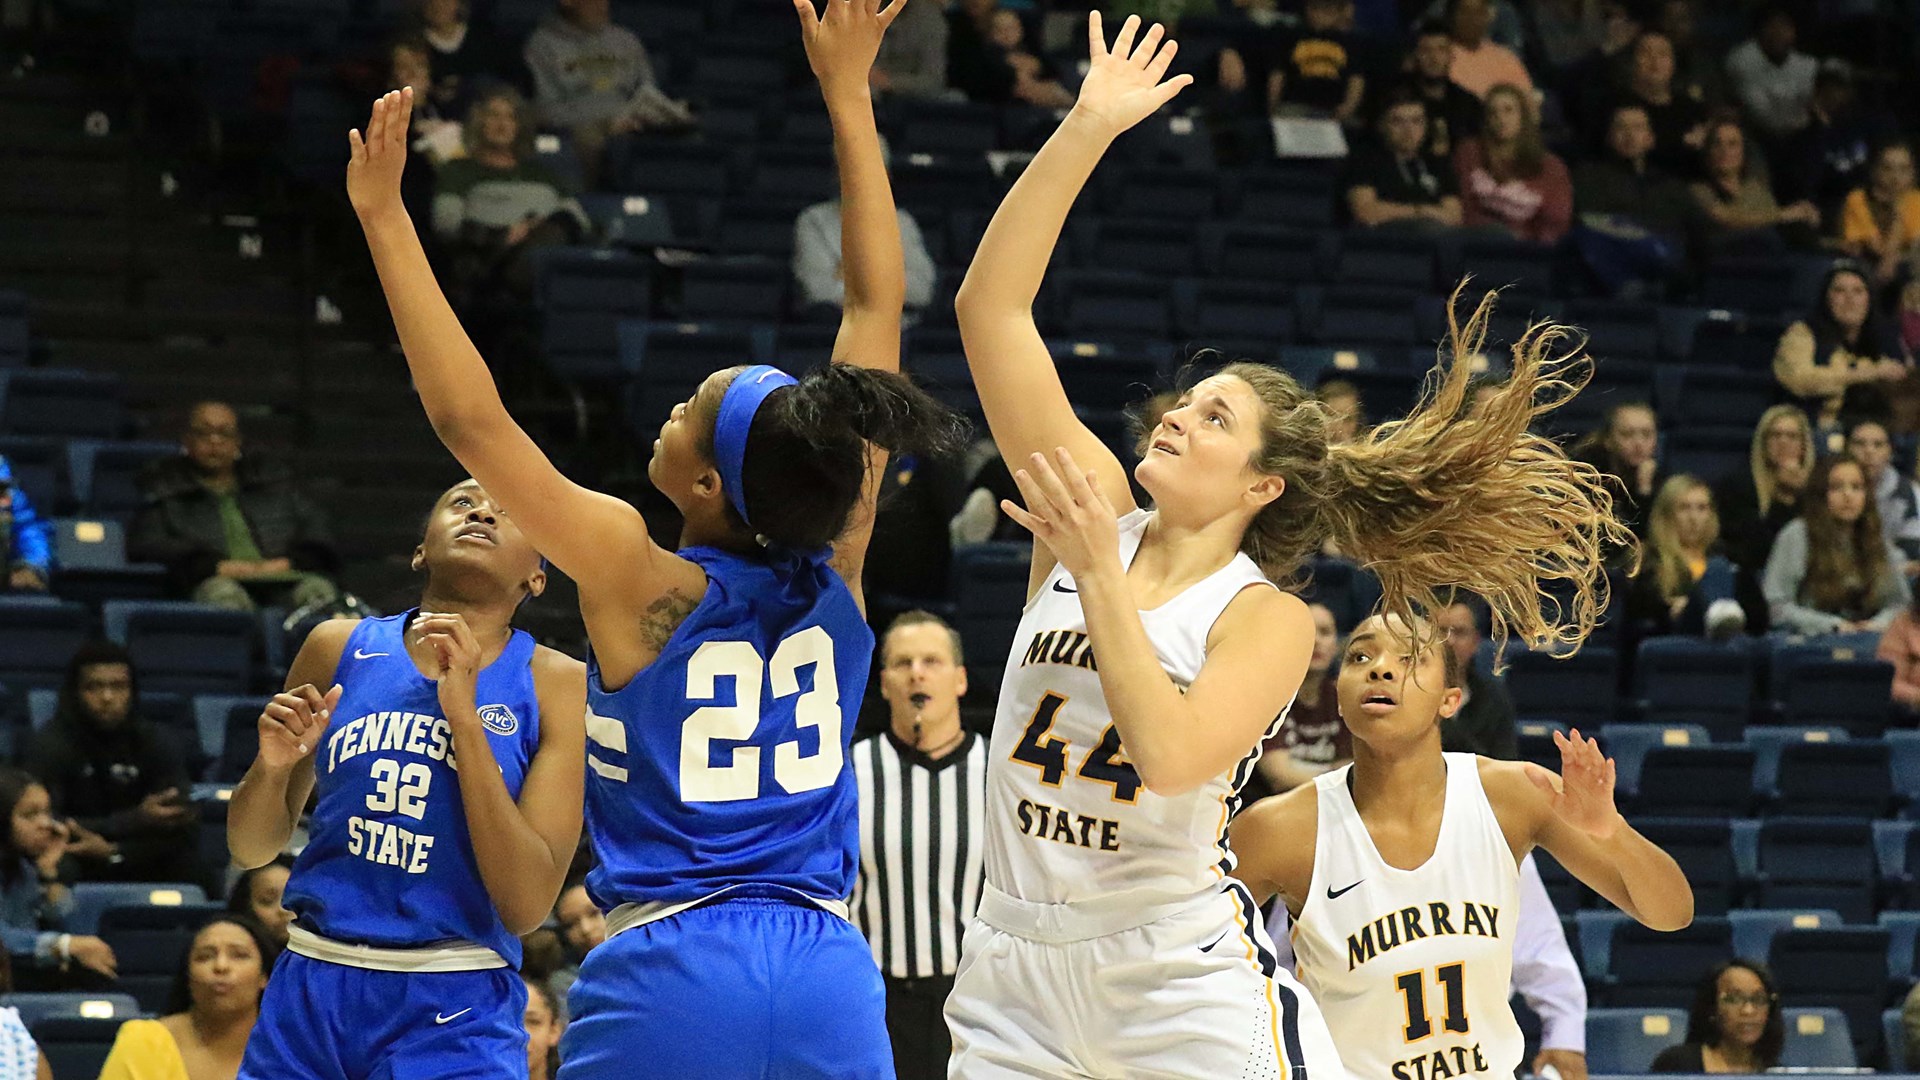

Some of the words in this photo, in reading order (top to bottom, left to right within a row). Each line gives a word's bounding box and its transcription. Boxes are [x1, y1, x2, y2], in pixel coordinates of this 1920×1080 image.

[327, 711, 459, 774] TENNES
[679, 625, 844, 802] 23
[1008, 689, 1146, 807] 44
[365, 758, 433, 821] 32
[348, 816, 435, 874] STATE
[1016, 798, 1122, 852] STATE
[1346, 901, 1501, 973] MURRAY
[1393, 959, 1472, 1045] 11
[1391, 1041, 1489, 1080] STATE
